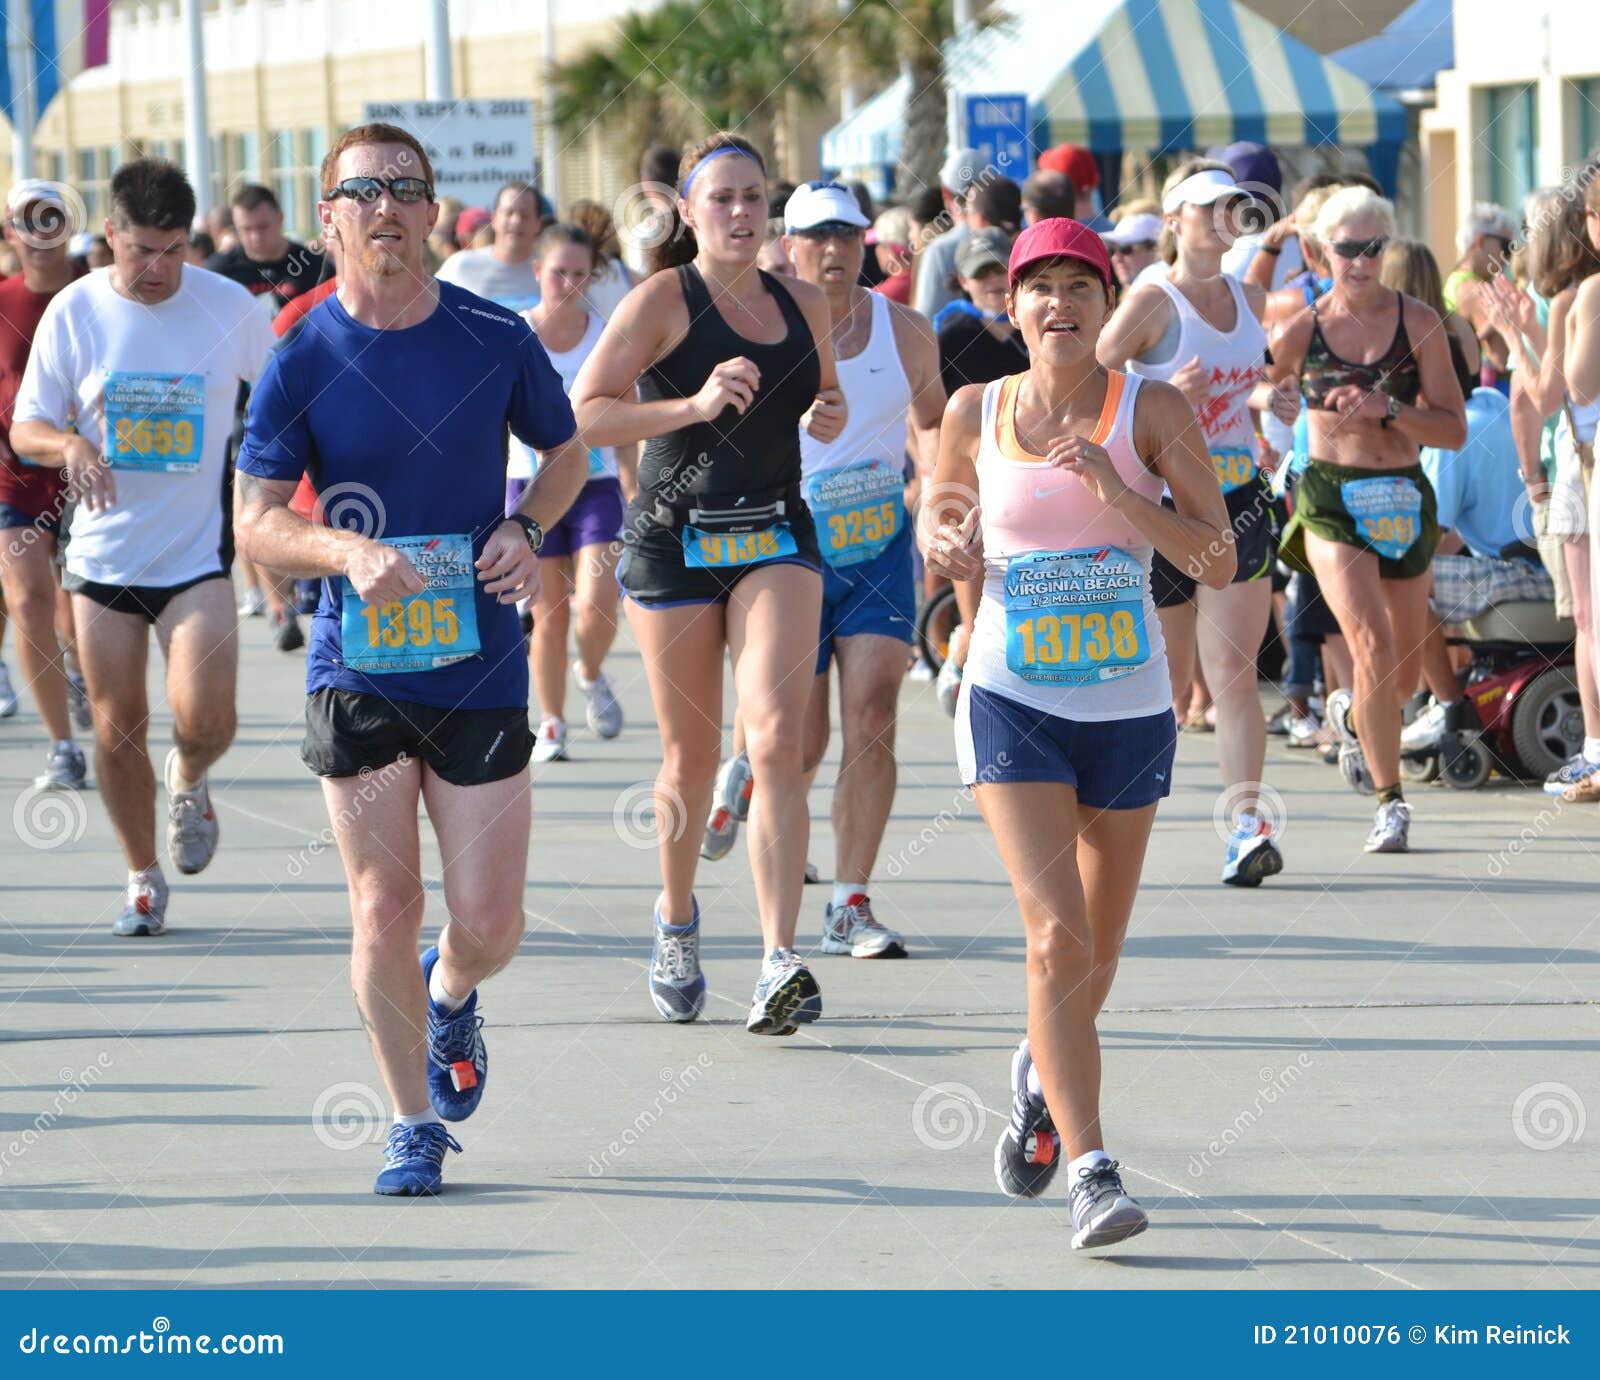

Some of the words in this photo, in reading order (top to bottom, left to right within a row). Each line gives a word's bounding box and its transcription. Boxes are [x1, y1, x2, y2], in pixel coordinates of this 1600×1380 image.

[116, 418, 194, 454] 9669
[828, 502, 896, 549] 3255
[1034, 552, 1099, 563] DODGE
[1007, 579, 1080, 598] VIRGINIA
[1084, 575, 1140, 592] BEACH
[1052, 591, 1118, 604] MARATHON
[361, 598, 459, 648] 1395
[1016, 610, 1138, 665] 13738
